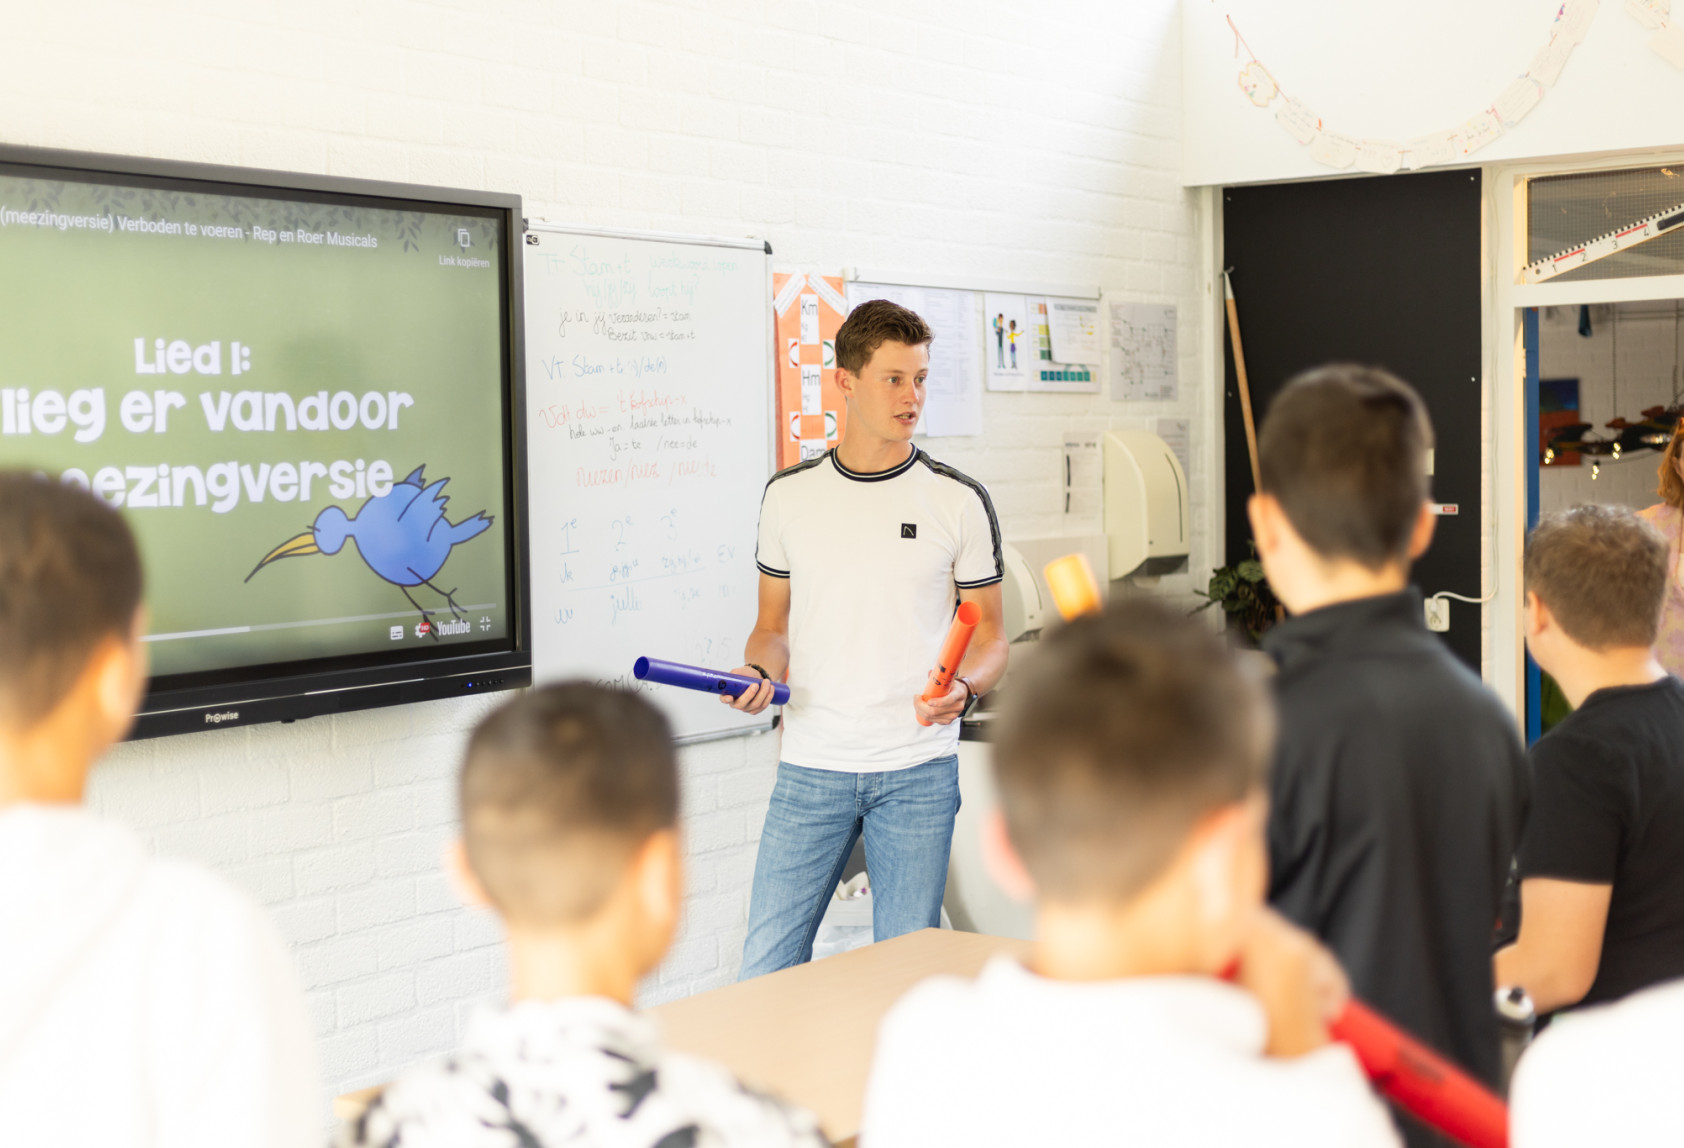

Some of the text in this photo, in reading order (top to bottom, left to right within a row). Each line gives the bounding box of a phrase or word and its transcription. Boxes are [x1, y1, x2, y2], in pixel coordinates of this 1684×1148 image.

[0, 206, 114, 232] (meezingversie)
[117, 215, 182, 236] Verboden
[184, 221, 198, 236] te
[200, 224, 243, 239] voeren
[253, 226, 277, 243] Rep
[279, 230, 294, 242] en
[297, 229, 324, 244] Roer
[327, 231, 378, 248] Musicals
[1643, 228, 1650, 237] 4
[1612, 240, 1619, 250] 3
[438, 255, 490, 269] Link kopiëren
[1580, 252, 1587, 262] 2
[1552, 263, 1558, 273] 1
[801, 299, 818, 316] Km
[575, 309, 589, 323] in
[134, 338, 221, 375] Lied
[802, 371, 821, 387] Hm
[0, 387, 415, 443] lieg er vandoor
[32, 458, 394, 514] ezingversie
[437, 618, 471, 637] YouTube
[205, 711, 239, 724] Prowise
